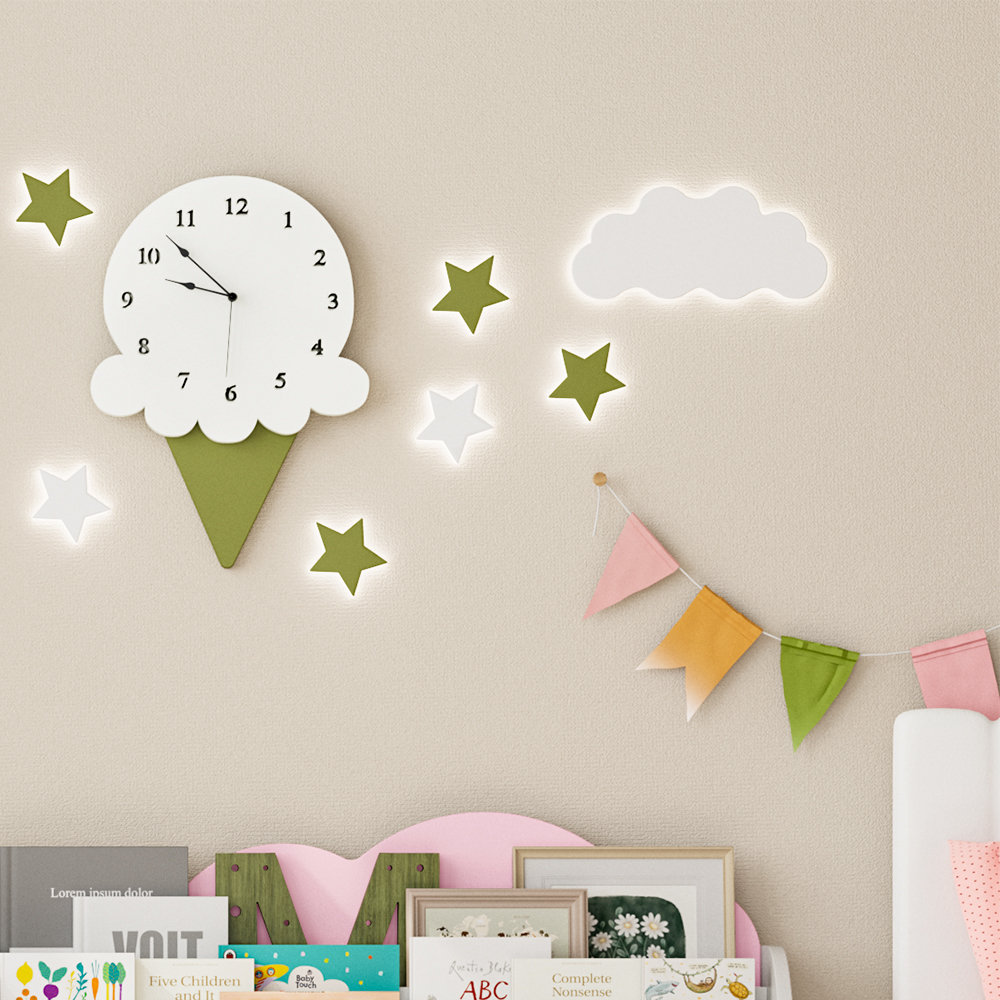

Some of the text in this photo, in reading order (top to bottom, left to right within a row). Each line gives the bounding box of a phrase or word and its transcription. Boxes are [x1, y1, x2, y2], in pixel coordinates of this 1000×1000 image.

[225, 198, 249, 215] 12
[176, 209, 195, 227] 11
[284, 212, 293, 228] 1
[138, 248, 160, 265] 10
[313, 250, 327, 266] 2
[121, 292, 133, 308] 9
[327, 293, 339, 310] 3
[138, 338, 150, 354] 8
[311, 339, 324, 356] 4
[178, 372, 190, 390] 7
[274, 372, 286, 389] 5
[225, 385, 237, 402] 6
[50, 887, 153, 898] Lorem ipsum dolor
[149, 975, 241, 987] Five Children
[296, 974, 314, 985] Baby
[296, 981, 317, 989] Touch
[552, 973, 612, 986] Complete
[175, 990, 215, 1000] and It
[552, 987, 612, 998] Nonsense
